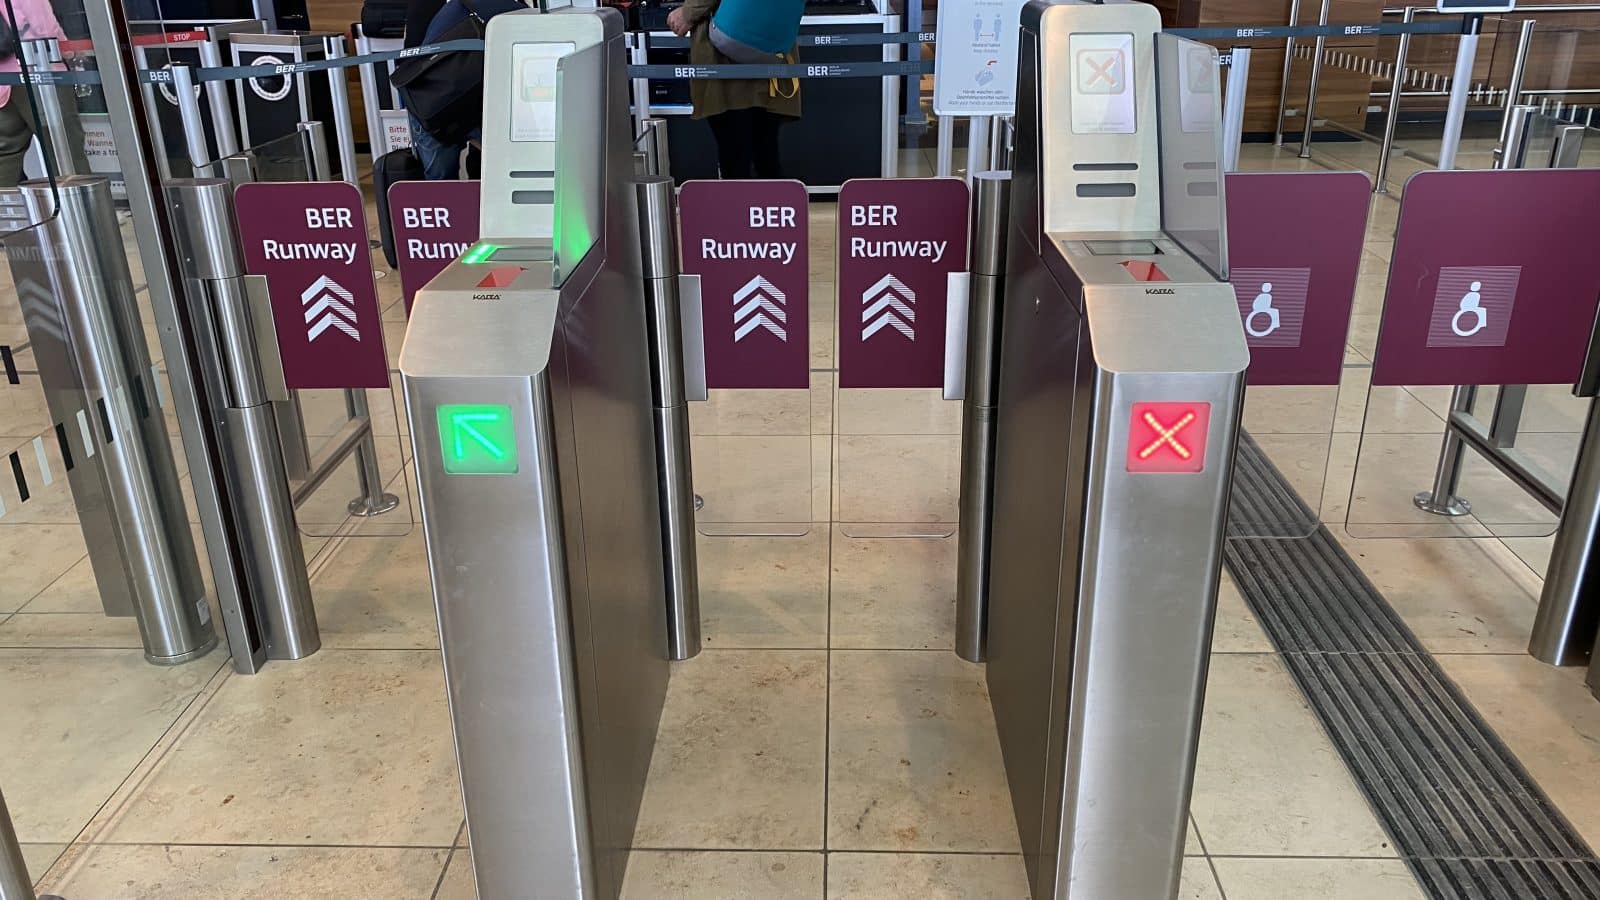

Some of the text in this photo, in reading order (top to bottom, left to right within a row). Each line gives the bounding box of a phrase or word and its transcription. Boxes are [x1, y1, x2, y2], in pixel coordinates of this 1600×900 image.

[1236, 29, 1254, 37] BER
[1344, 26, 1362, 35] BER
[173, 33, 190, 41] STOP
[814, 36, 831, 45] BER
[918, 33, 935, 41] BER
[399, 49, 420, 58] BER
[1219, 55, 1232, 65] ER
[275, 64, 296, 74] BER
[674, 67, 696, 78] BER
[807, 65, 828, 76] BER
[149, 71, 170, 80] BER
[305, 207, 353, 229] BER
[403, 207, 451, 229] BER
[749, 206, 796, 228] BER
[851, 205, 898, 226] BER
[262, 239, 358, 265] Runway
[408, 238, 473, 260] Runw
[701, 238, 797, 265] Runway
[851, 237, 947, 263] Runway
